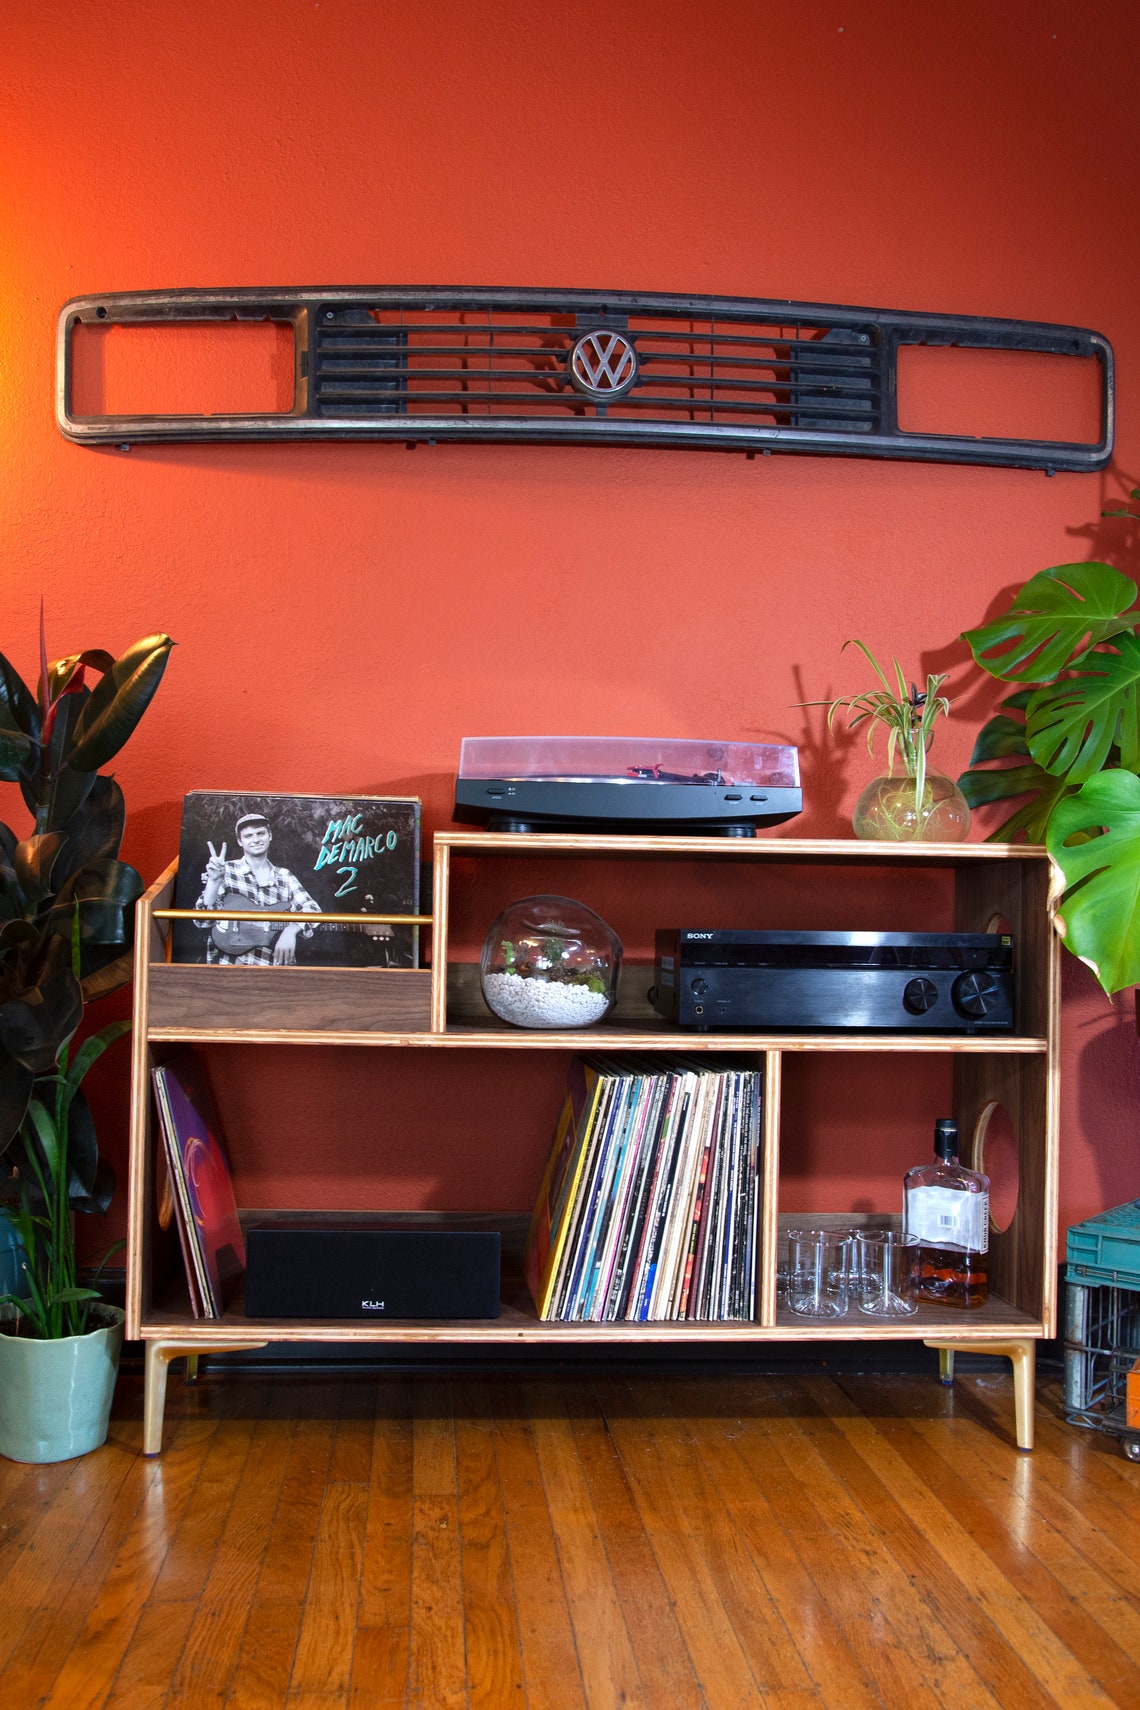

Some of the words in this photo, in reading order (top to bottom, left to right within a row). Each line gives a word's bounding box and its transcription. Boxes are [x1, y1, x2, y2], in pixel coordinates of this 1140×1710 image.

[573, 331, 636, 392] VW
[321, 813, 363, 844] MAC
[313, 830, 397, 871] DEMARCO
[334, 866, 358, 897] 2
[686, 932, 714, 940] SONY
